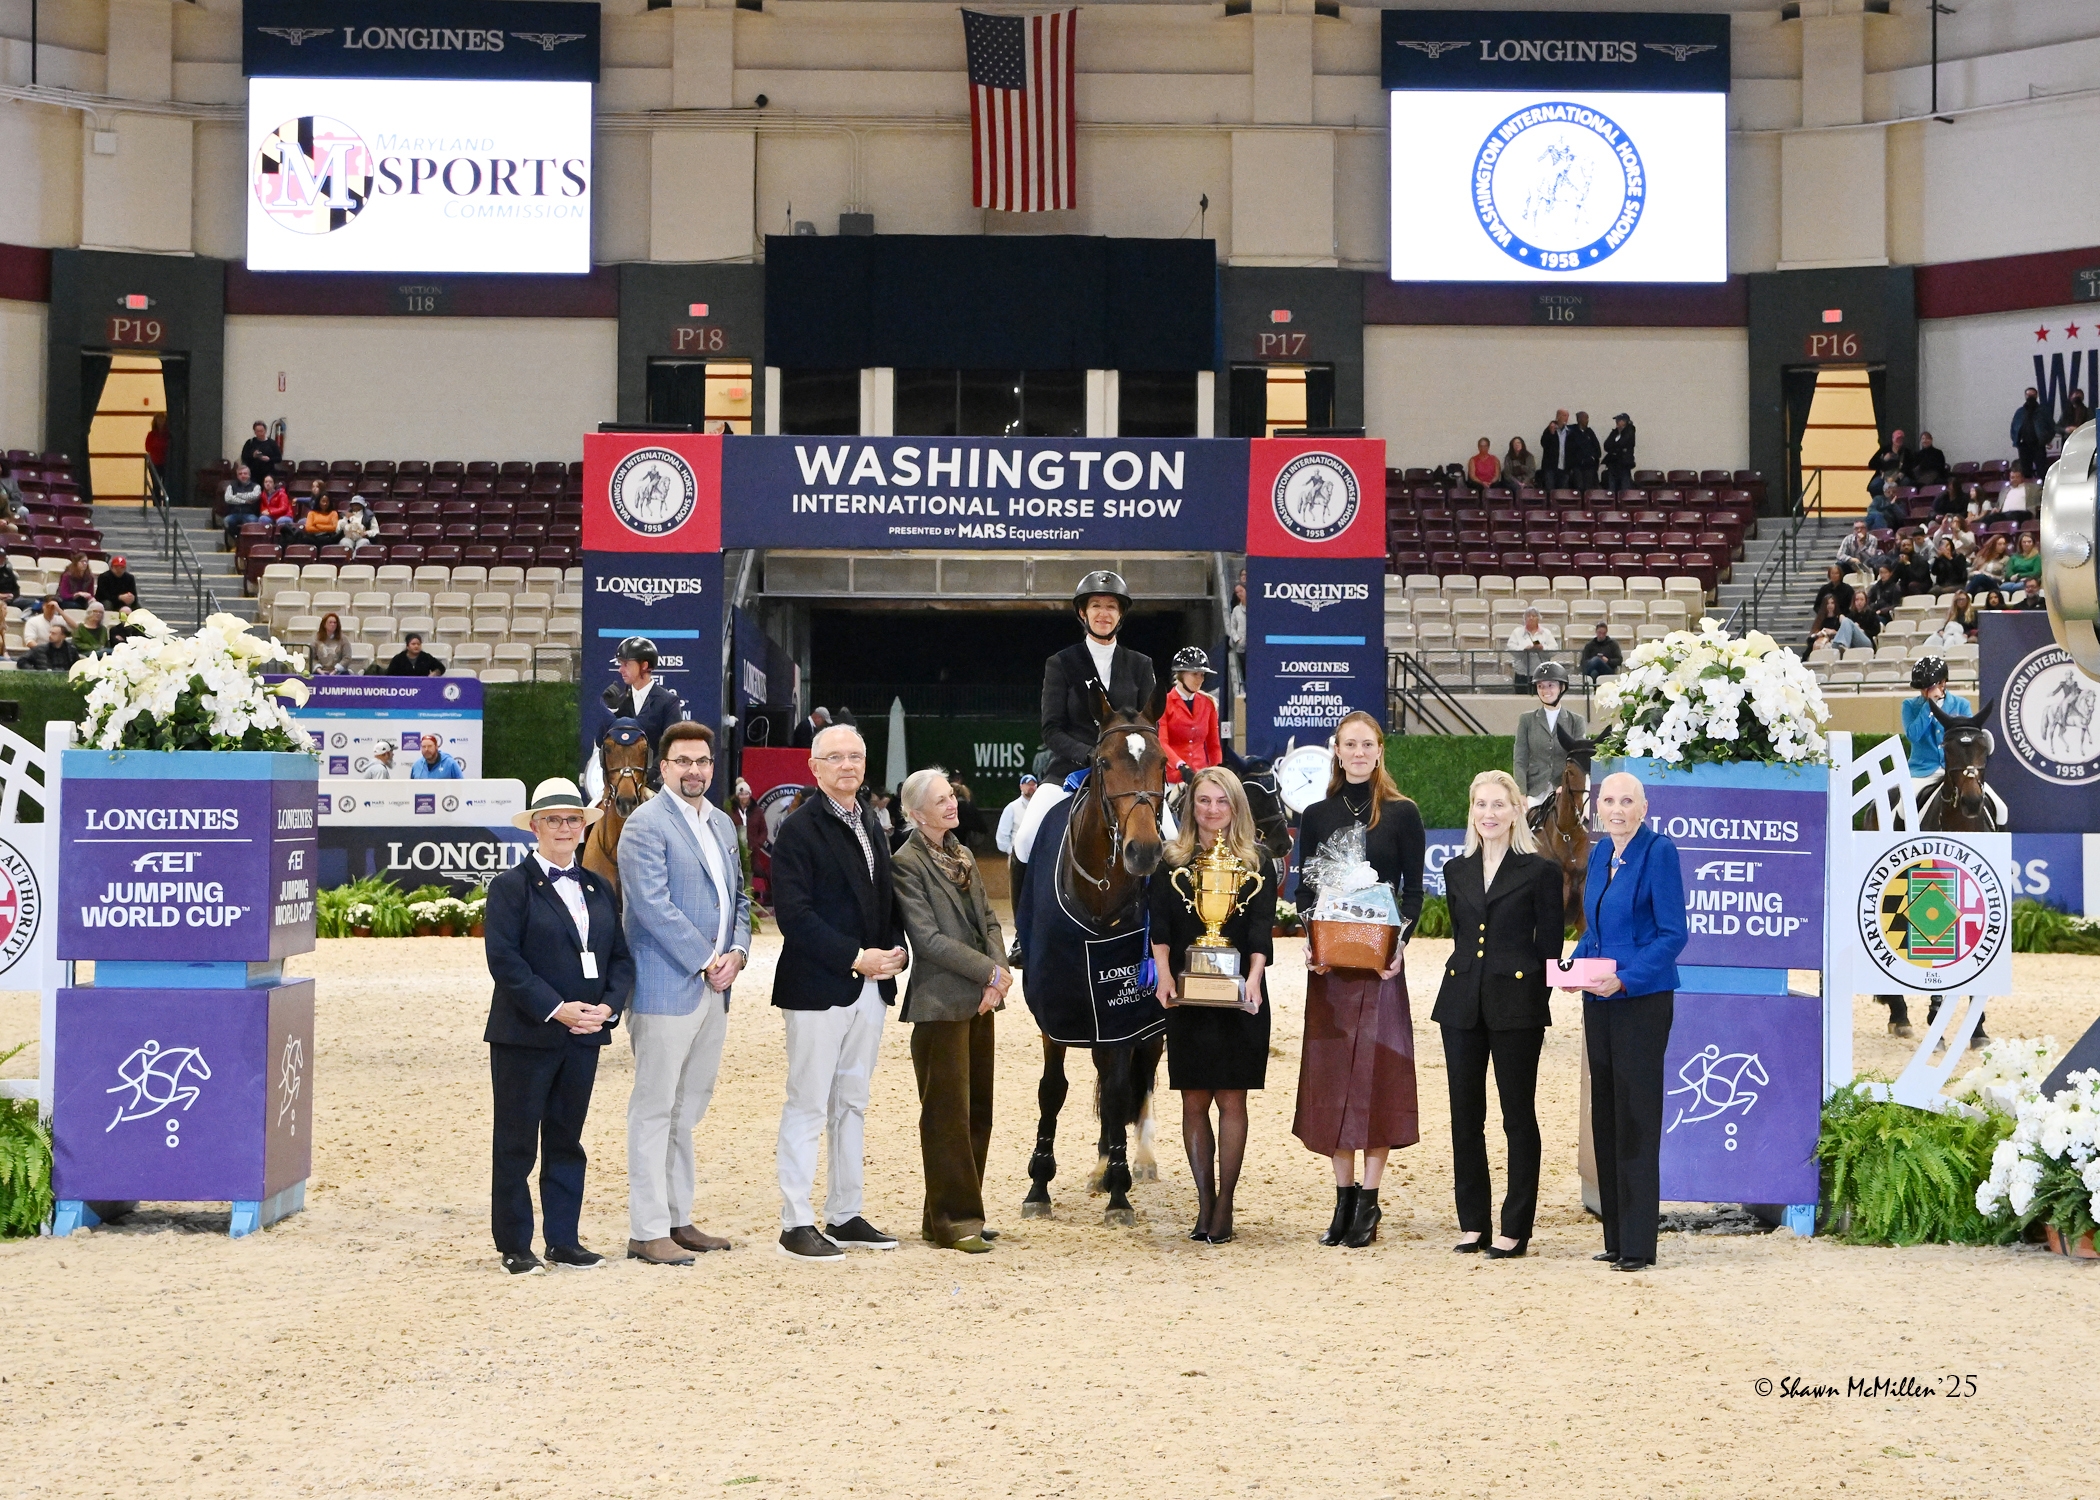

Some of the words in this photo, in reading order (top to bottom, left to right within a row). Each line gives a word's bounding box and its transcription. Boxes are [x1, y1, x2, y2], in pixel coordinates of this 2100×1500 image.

[343, 27, 505, 52] LONGINES
[1479, 39, 1638, 63] LONGINES
[1498, 105, 1619, 145] INTERNATIONAL
[376, 133, 494, 152] MARYLAND
[377, 156, 586, 198] SPORTS
[1616, 141, 1642, 197] HORSE
[1476, 137, 1513, 248] WASHINGTON
[443, 200, 584, 219] COMMISSION
[1605, 200, 1640, 249] SHOW
[1540, 252, 1580, 268] 1958
[399, 285, 442, 295] SECTION
[1539, 295, 1582, 304] SECTION
[406, 296, 435, 312] 118
[1546, 306, 1575, 321] 116
[112, 318, 161, 343] P19
[676, 328, 724, 351] P18
[1259, 333, 1306, 355] P17
[1810, 333, 1857, 357] P16
[625, 452, 683, 472] INTERNATIONAL
[794, 445, 1185, 491] WASHINGTON
[1289, 456, 1345, 476] INTERNATIONAL
[613, 467, 631, 522] WASHINGTON
[680, 469, 693, 497] HORSE
[1344, 474, 1356, 502] HORSE
[674, 498, 691, 523] SHOW
[792, 494, 1000, 516] INTERNATIONAL
[1008, 498, 1094, 518] HORSE
[1102, 498, 1182, 518] SHOW
[1277, 472, 1294, 527] WASHINGTON
[1337, 503, 1354, 528] SHOW
[643, 524, 662, 533] 1958
[888, 526, 942, 536] PRESENTED
[943, 527, 956, 536] BY
[958, 523, 1006, 539] MARS
[1306, 529, 1325, 538] 1958
[596, 576, 702, 594] LONGINES
[1263, 582, 1369, 600] LONGINES
[1281, 661, 1350, 673] LONGINES
[319, 686, 362, 696] JUMPING
[363, 687, 398, 697] WORLD
[1287, 695, 1343, 706] JUMPING
[1273, 716, 1343, 728] WASHINGT
[1279, 705, 1324, 717] WORLD
[2008, 674, 2036, 761] WASHINGTON
[974, 742, 1025, 768] WIHS
[2055, 764, 2085, 778] 1958
[85, 808, 239, 831] LONGINES
[277, 808, 313, 830] LONGINES
[1651, 816, 1799, 842] LONGINES
[387, 842, 537, 870] LONGIN
[99, 882, 224, 904] JUMPING
[279, 879, 309, 901] JUMPING
[1685, 889, 1783, 913] UMPING
[1, 855, 35, 961] AUTHORITY
[275, 903, 298, 926] WORLD
[1863, 867, 1897, 968] MARYLAND
[1890, 842, 1971, 867] STADIUM
[1970, 863, 2002, 967] AUTHORITY
[81, 906, 181, 928] WORLD
[1107, 993, 1141, 1007] WORLD
